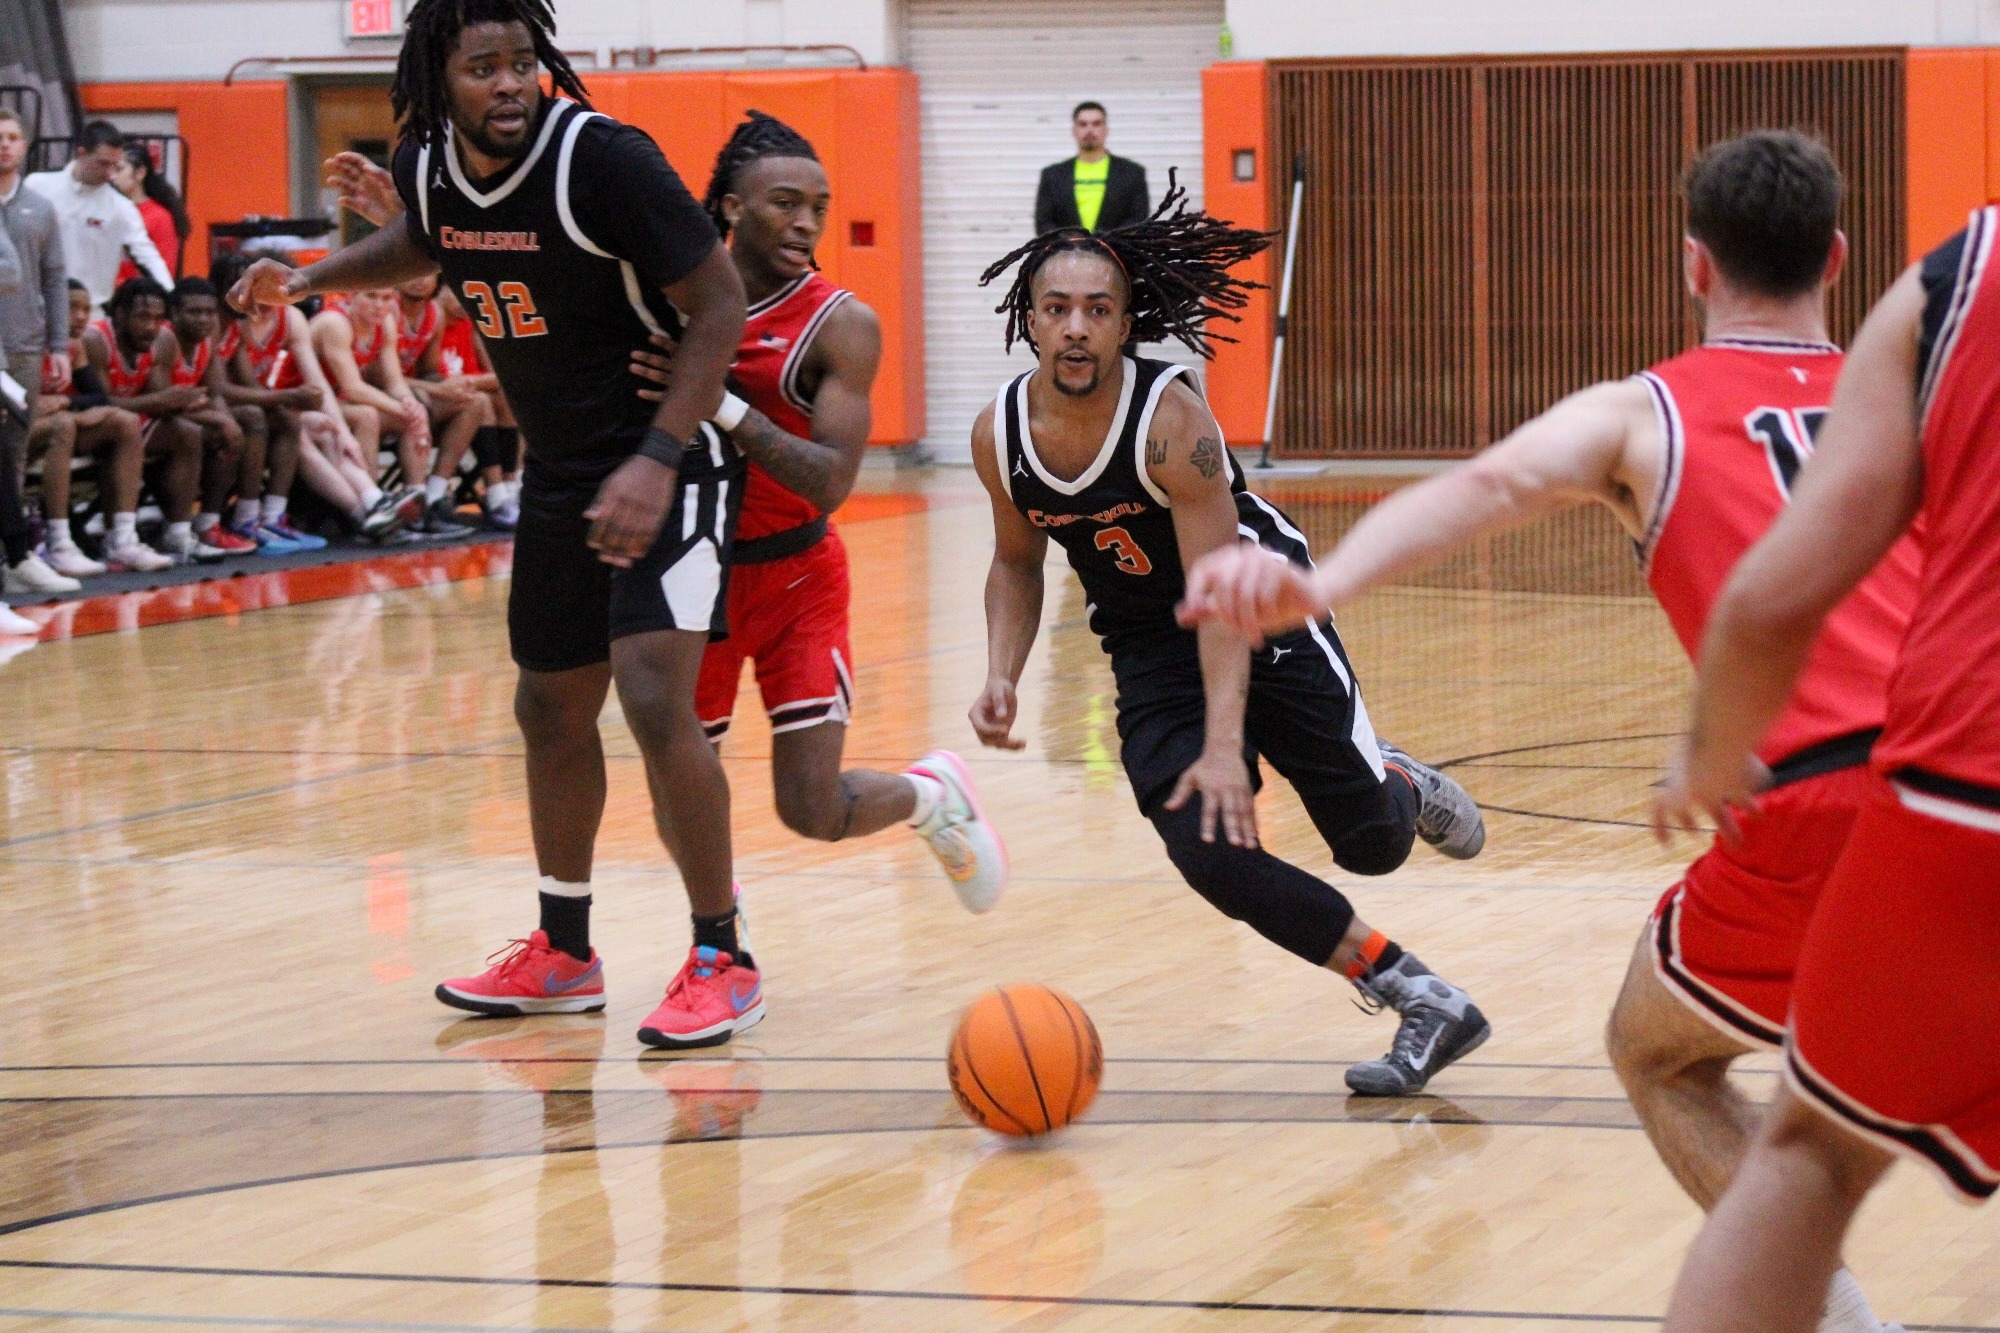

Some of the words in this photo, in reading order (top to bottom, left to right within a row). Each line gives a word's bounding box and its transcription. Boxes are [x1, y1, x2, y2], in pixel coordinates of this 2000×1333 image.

[351, 0, 391, 34] EXIT
[441, 226, 541, 251] COBLESKILL
[462, 280, 549, 338] 32
[1743, 406, 1832, 502] 1
[1028, 502, 1147, 527] COBSKILL
[1094, 526, 1152, 575] 3
